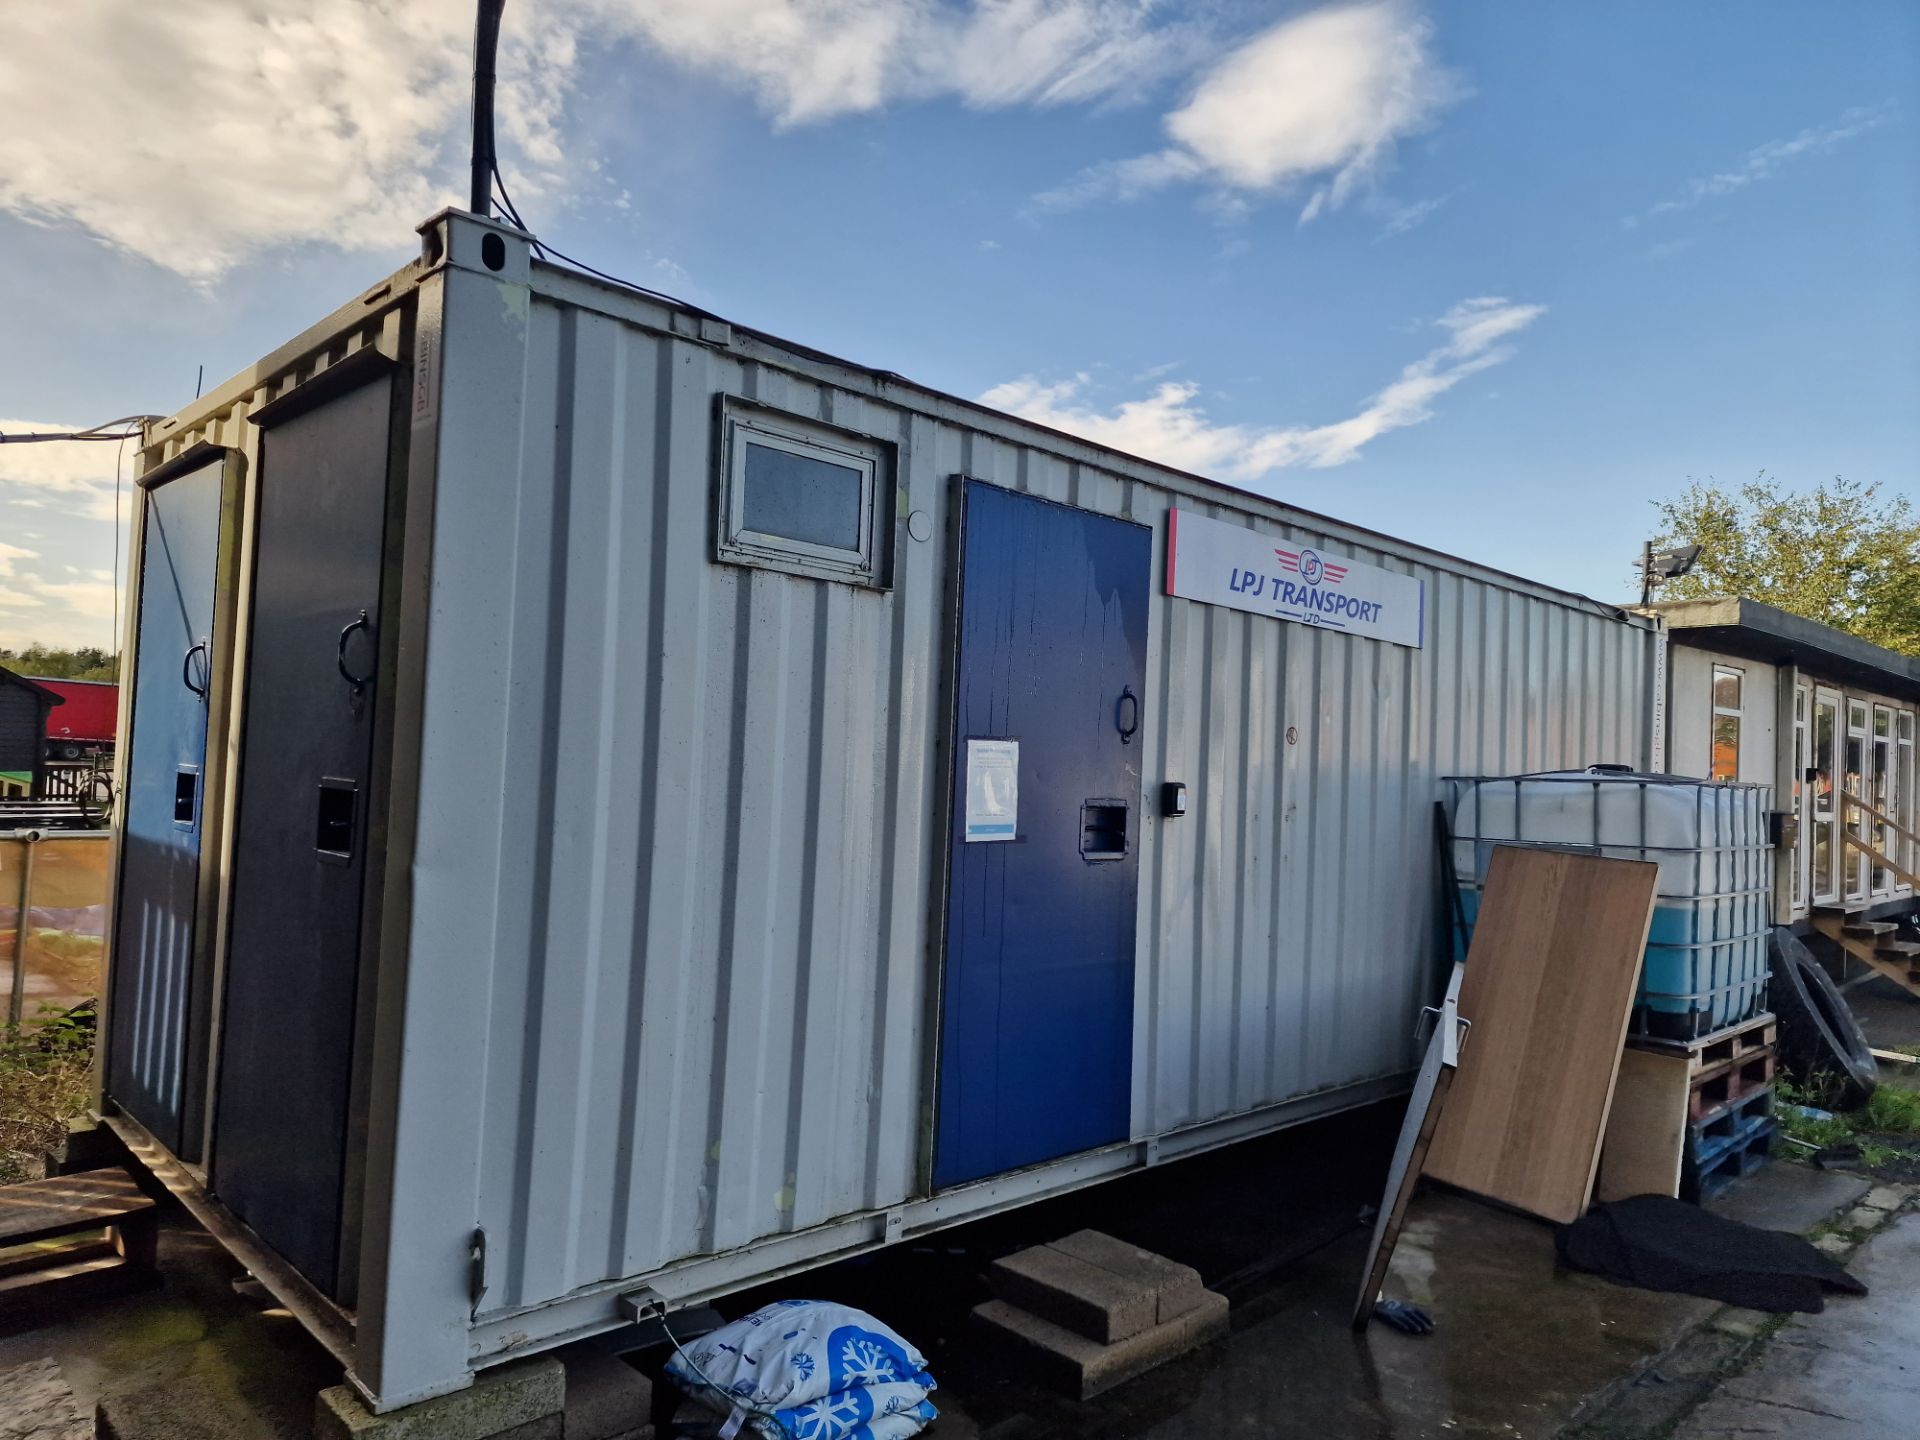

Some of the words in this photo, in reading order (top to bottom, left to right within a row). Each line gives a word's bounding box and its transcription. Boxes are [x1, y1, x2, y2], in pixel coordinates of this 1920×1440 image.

[1229, 568, 1265, 597] LPJ
[1271, 578, 1383, 624] TRANSPORT
[1303, 612, 1321, 625] LTD
